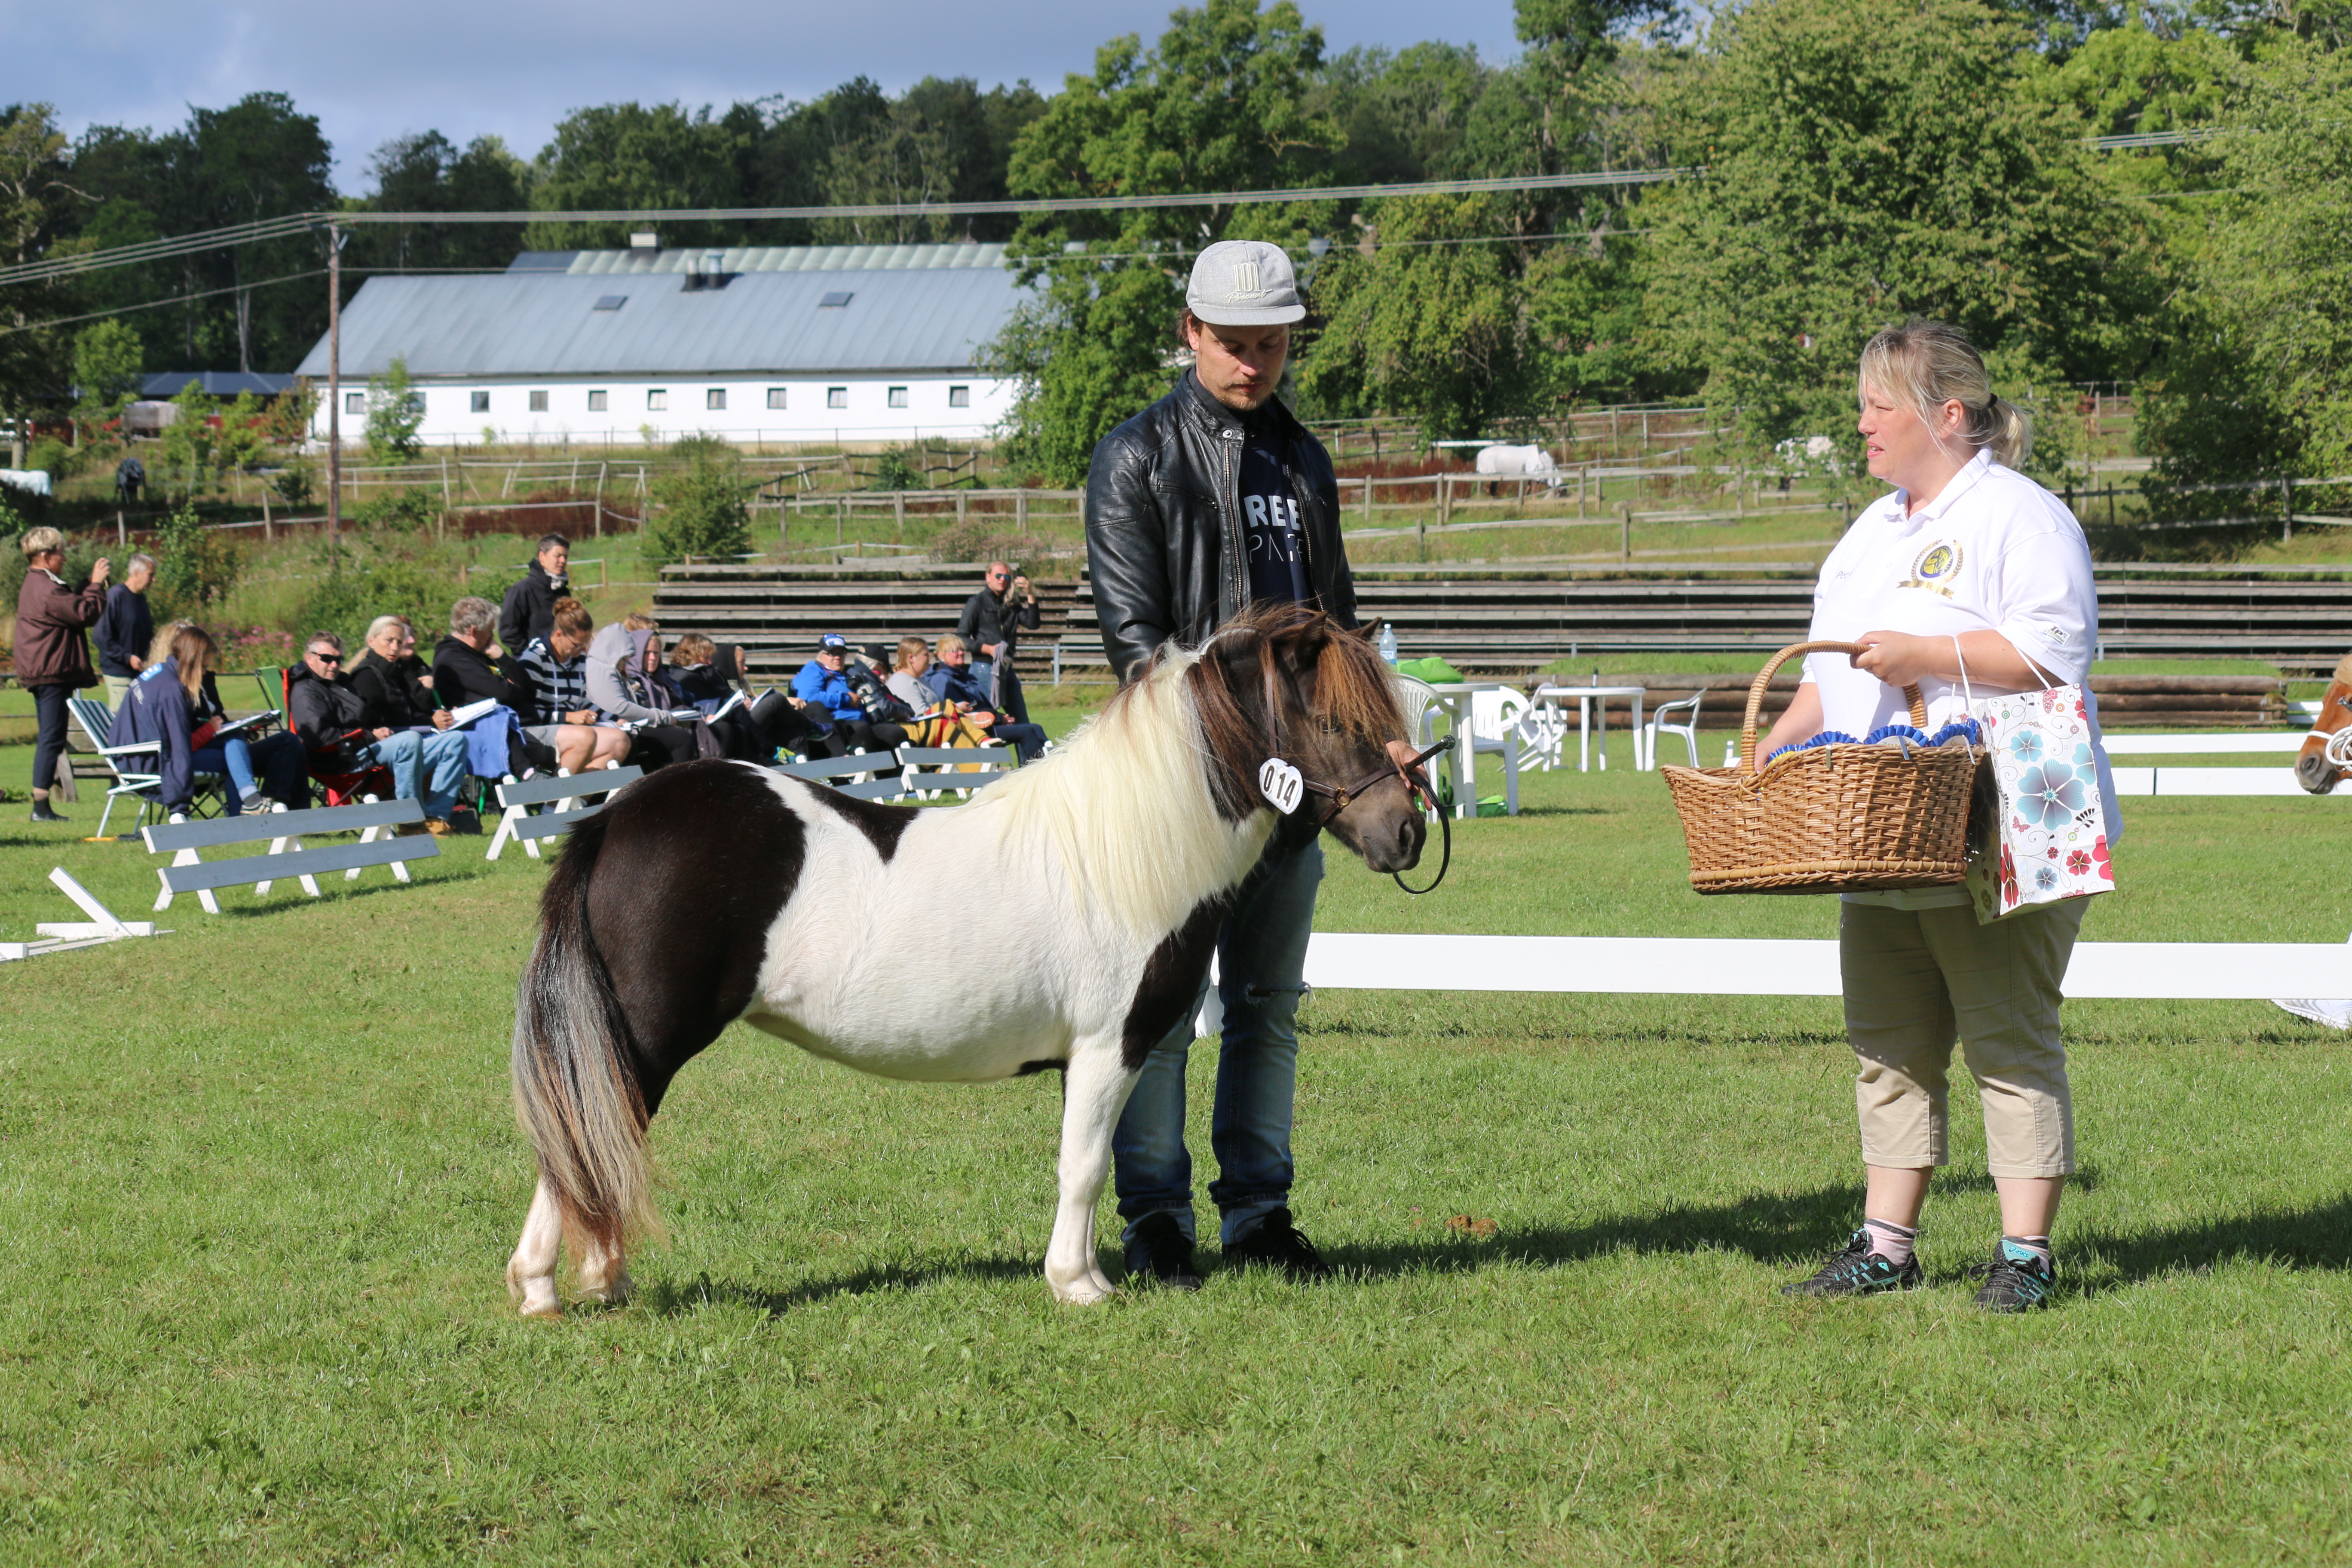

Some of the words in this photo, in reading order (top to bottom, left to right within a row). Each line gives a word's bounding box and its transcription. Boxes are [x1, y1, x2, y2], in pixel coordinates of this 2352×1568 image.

[1233, 262, 1261, 292] 101
[1225, 289, 1273, 303] Percent
[1939, 588, 1951, 597] 2017
[1264, 765, 1297, 807] 014
